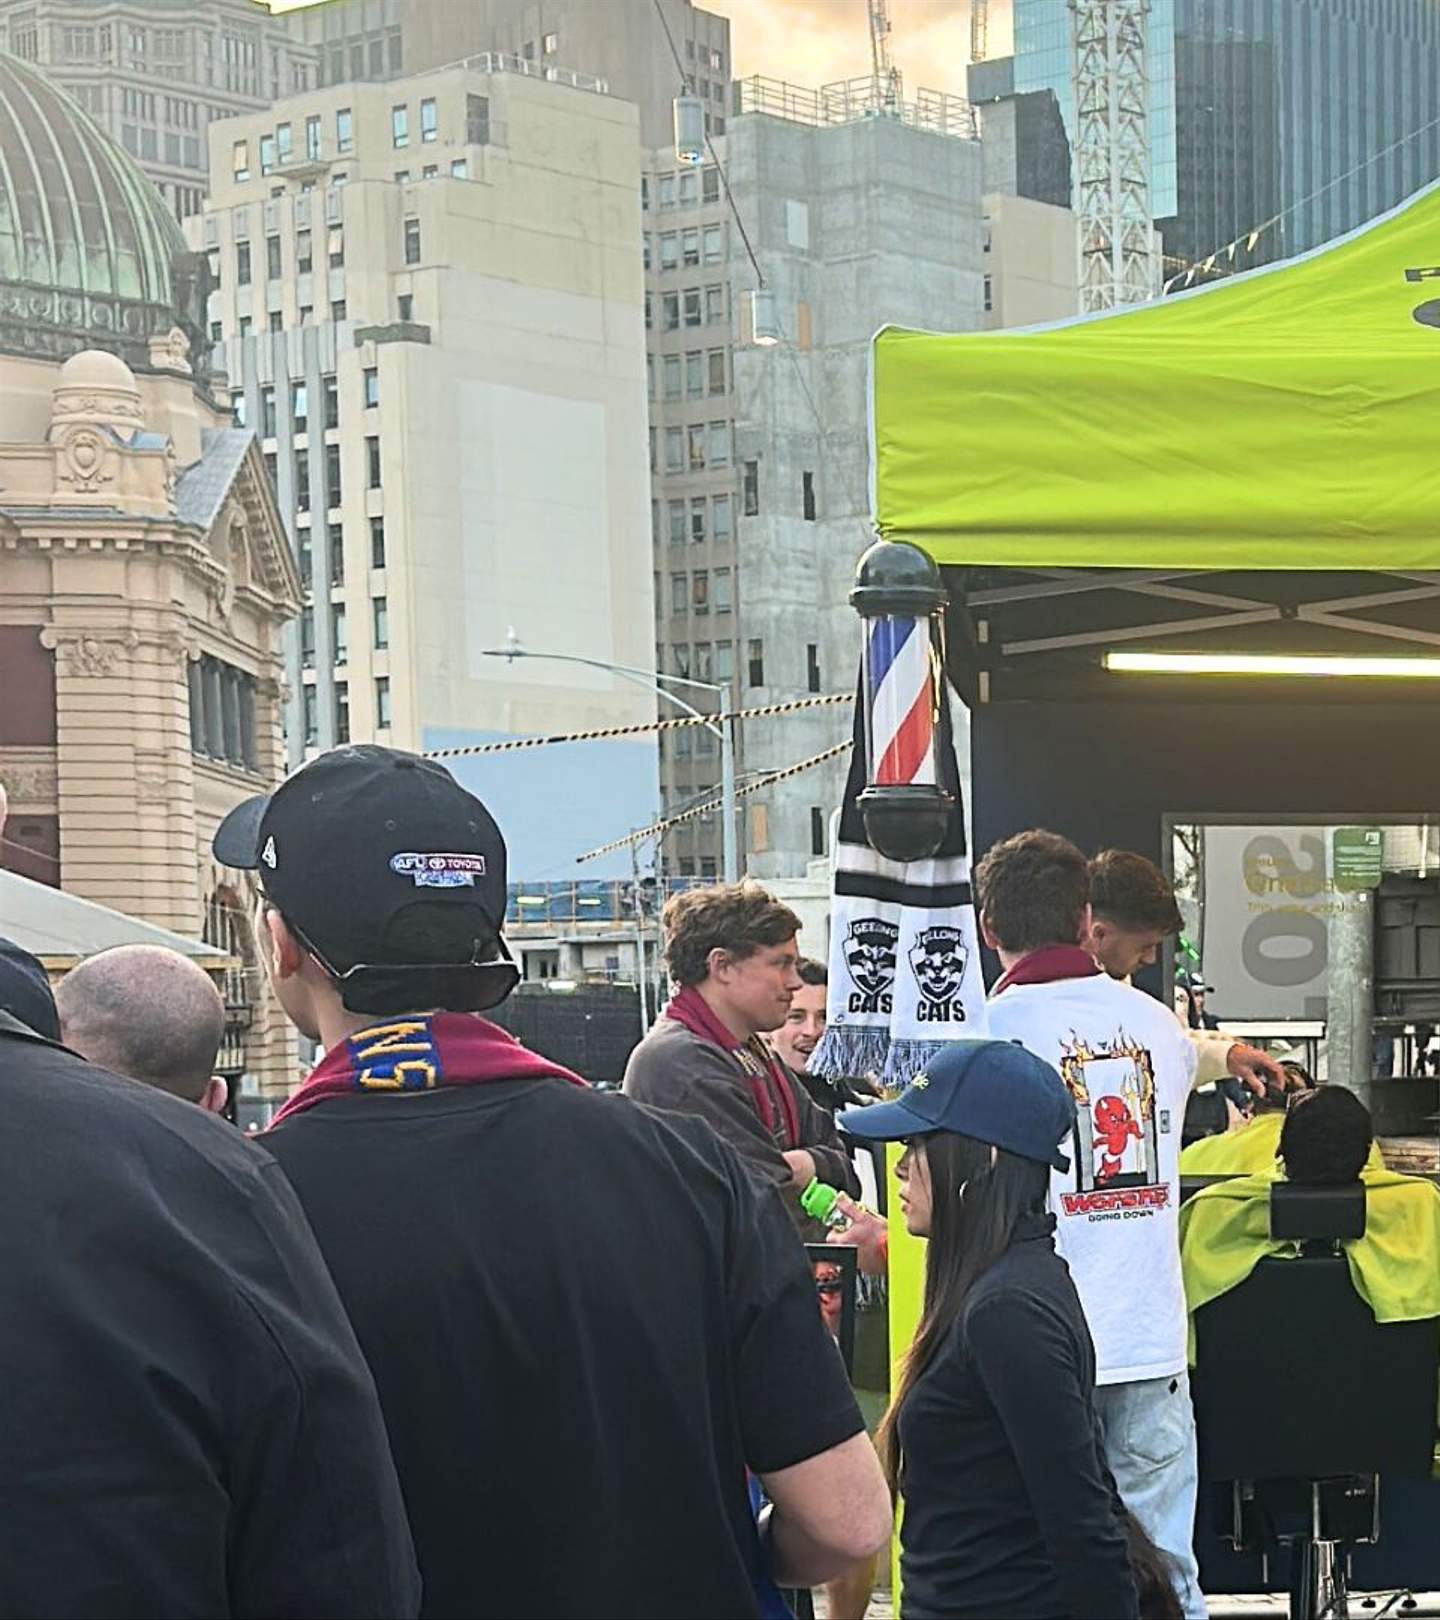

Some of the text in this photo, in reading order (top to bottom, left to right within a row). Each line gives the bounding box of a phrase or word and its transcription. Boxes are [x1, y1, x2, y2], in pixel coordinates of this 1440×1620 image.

[848, 992, 893, 1014] CATS
[917, 1000, 966, 1022] CATS
[1088, 1210, 1154, 1222] GOING DOWN
